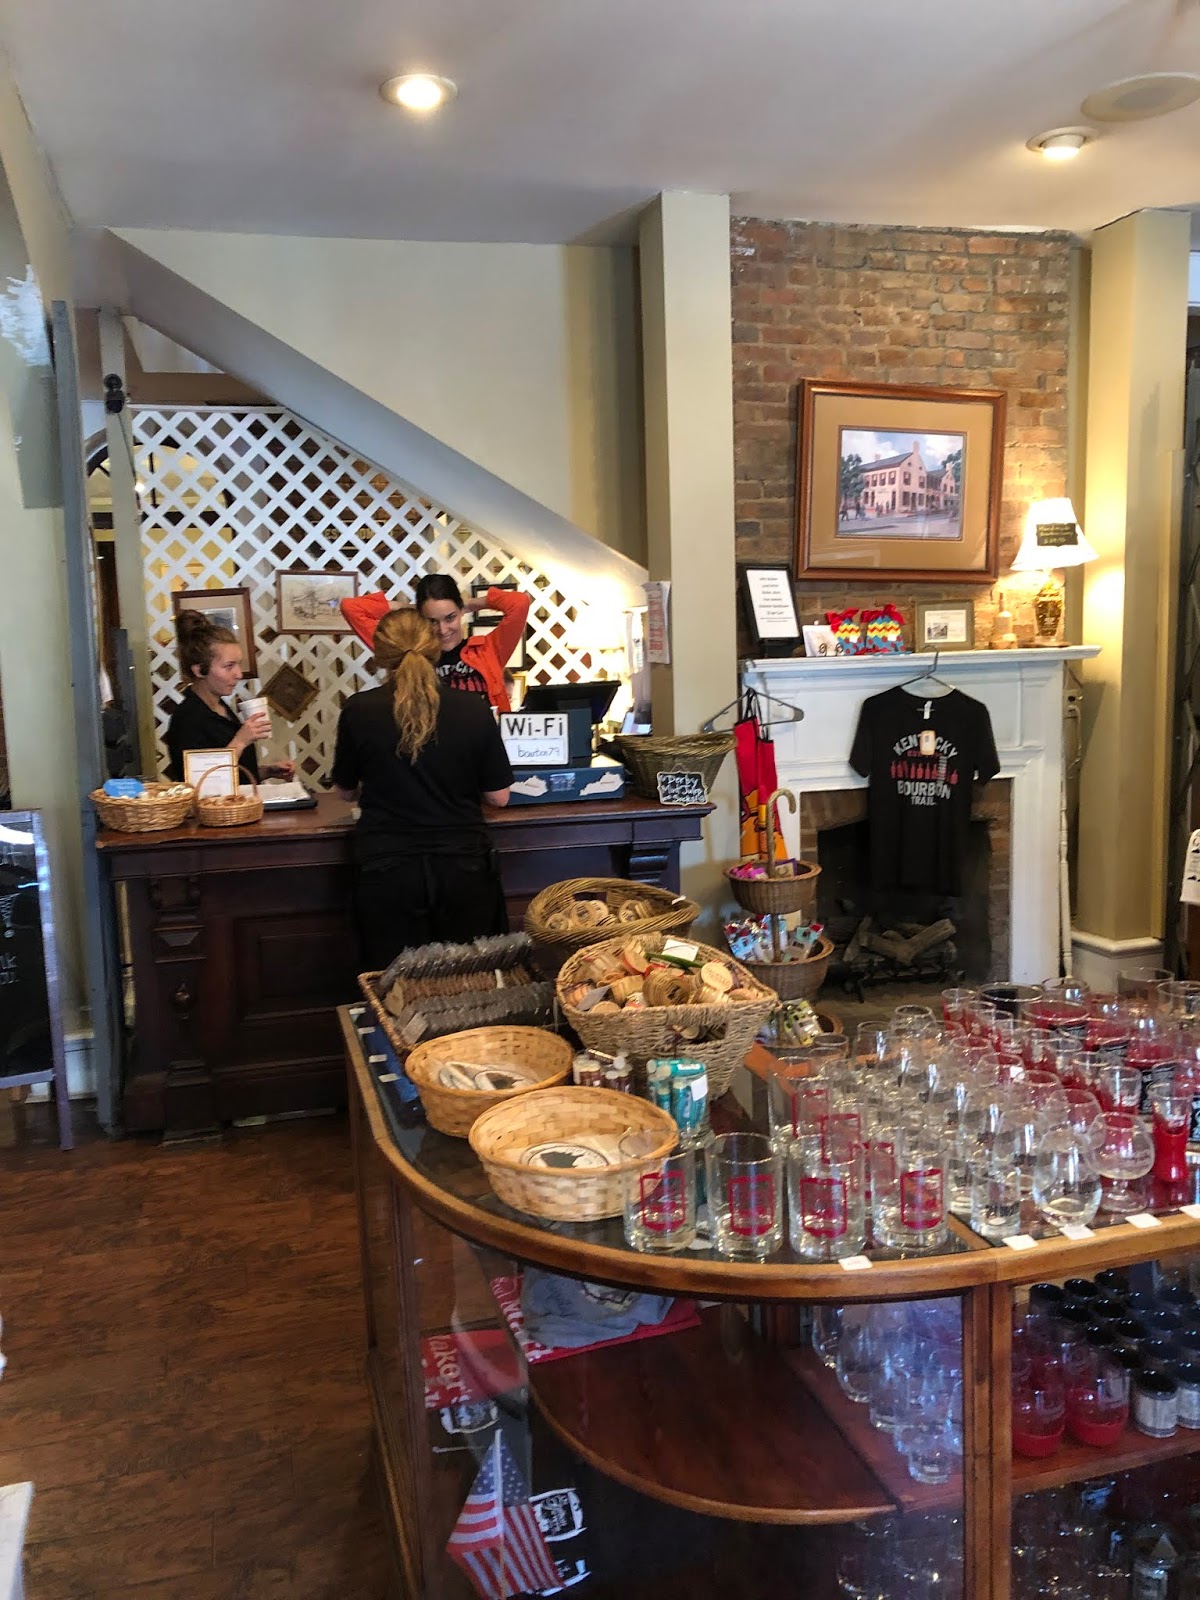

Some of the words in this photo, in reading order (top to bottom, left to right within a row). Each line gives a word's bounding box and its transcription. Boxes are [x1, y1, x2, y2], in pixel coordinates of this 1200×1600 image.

[505, 717, 563, 736] Wi-Fi
[892, 733, 958, 759] KENCKY
[667, 774, 699, 790] Derby
[897, 780, 951, 800] BOURBON
[911, 796, 937, 806] TRAIL
